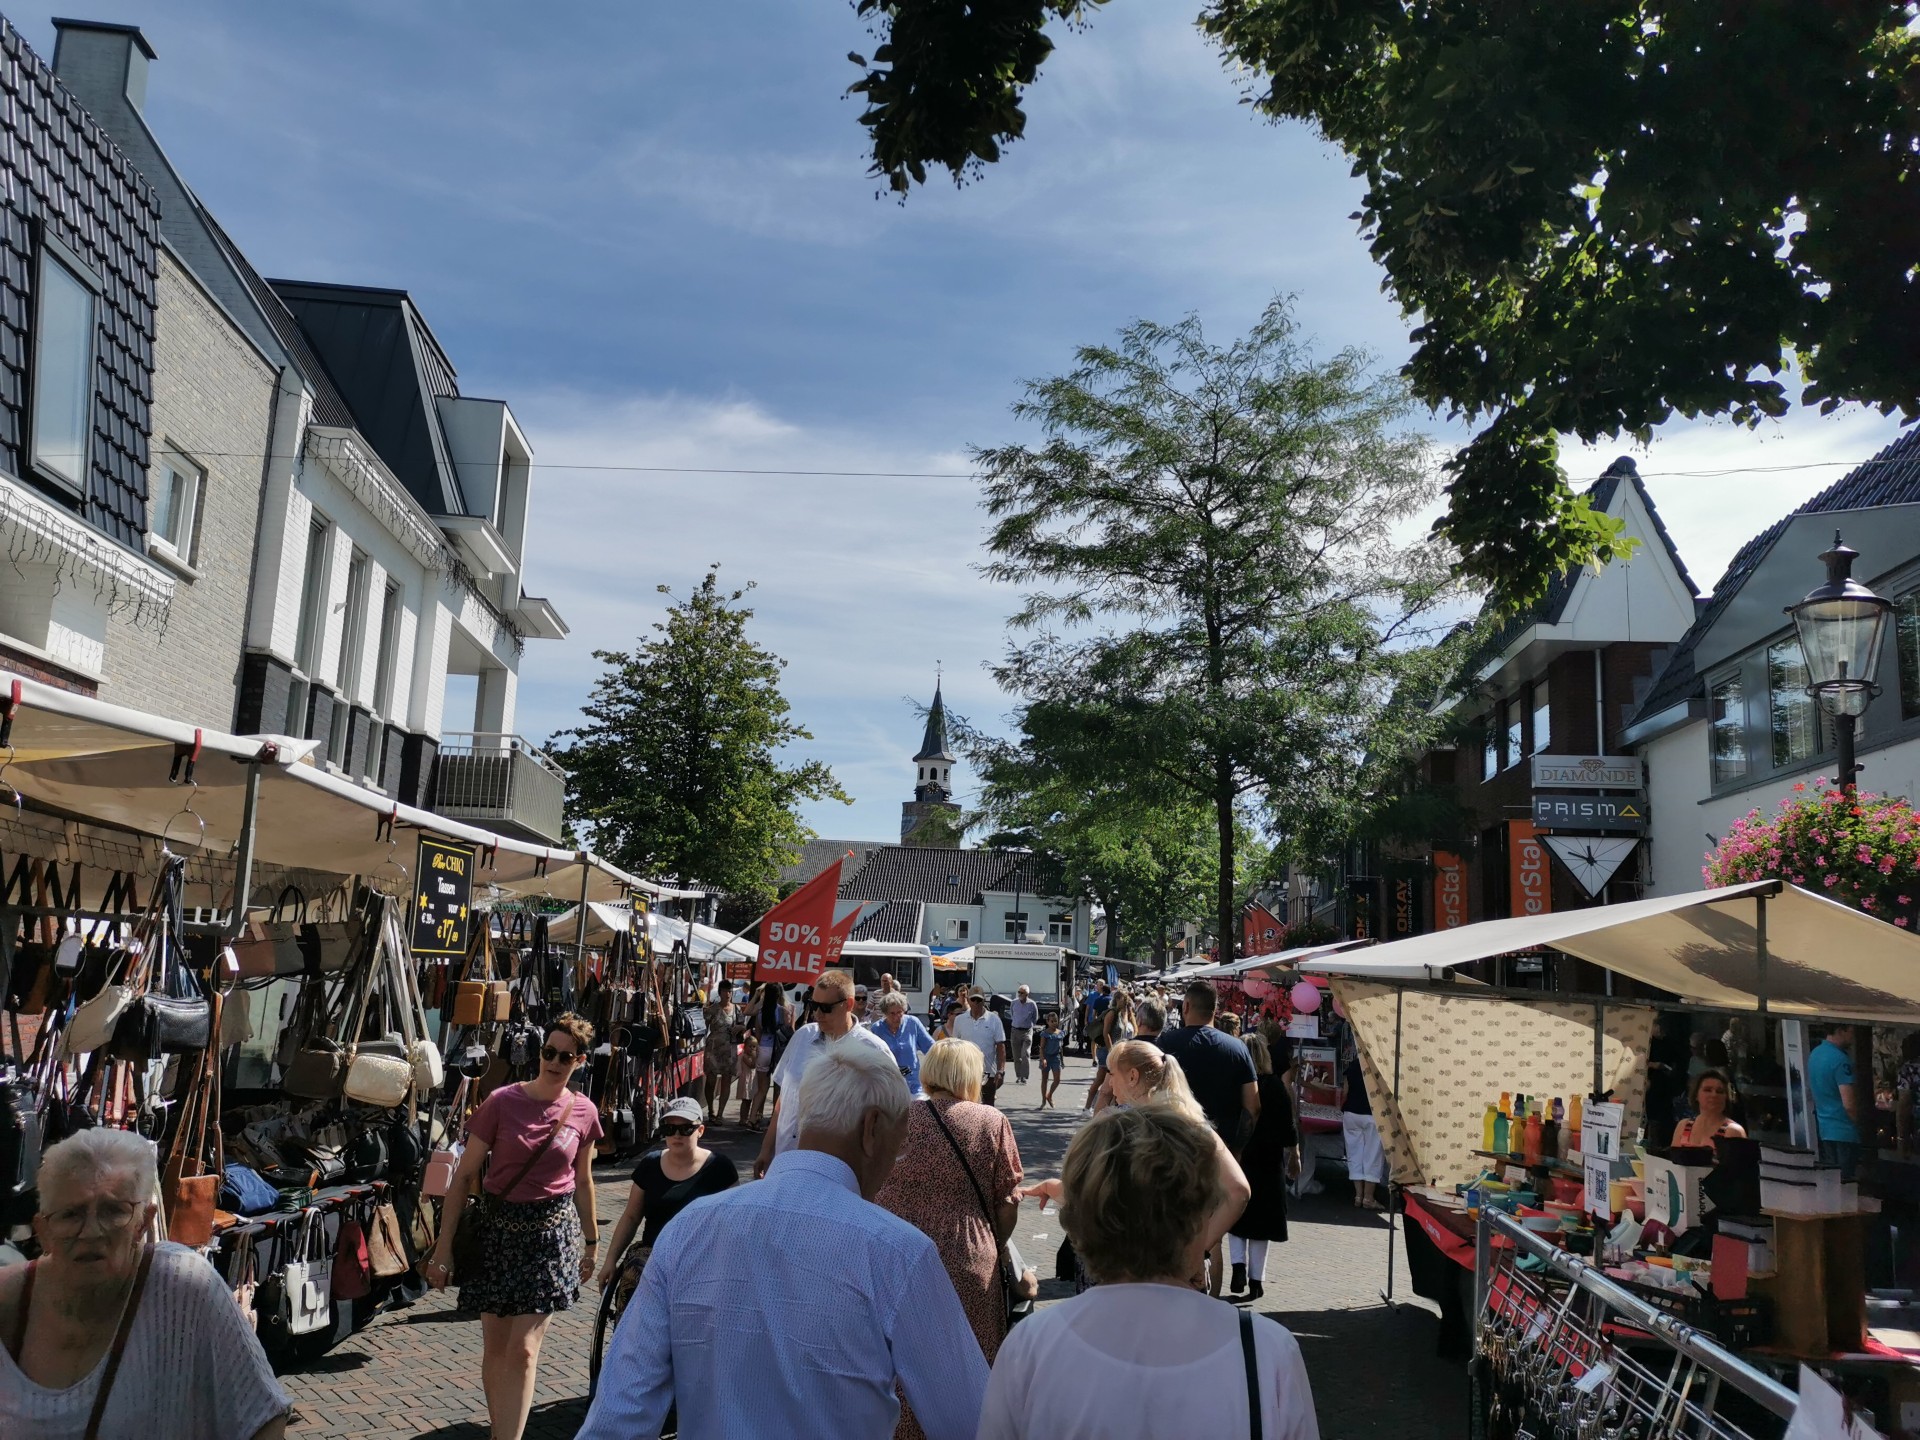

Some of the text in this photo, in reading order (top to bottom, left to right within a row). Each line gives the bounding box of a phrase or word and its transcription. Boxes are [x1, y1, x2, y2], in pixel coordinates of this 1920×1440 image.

[1541, 769, 1637, 782] DIAMONDE
[446, 855, 464, 876] CHIQ
[1519, 838, 1543, 913] erStal
[438, 877, 456, 895] Tassen
[1442, 864, 1460, 929] erStal
[1356, 893, 1366, 939] OKY
[1396, 879, 1408, 932] OKAY
[769, 921, 821, 946] 50%
[762, 949, 822, 974] SALE
[826, 947, 841, 957] LE
